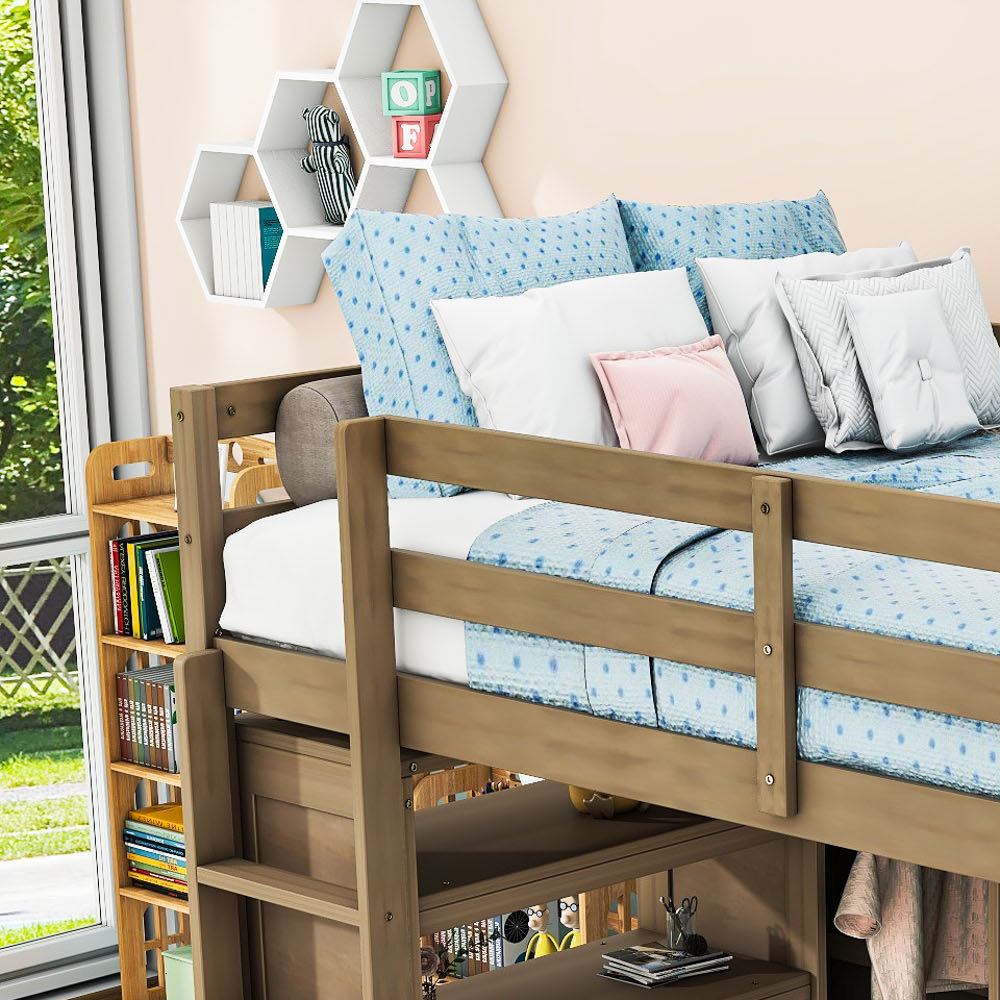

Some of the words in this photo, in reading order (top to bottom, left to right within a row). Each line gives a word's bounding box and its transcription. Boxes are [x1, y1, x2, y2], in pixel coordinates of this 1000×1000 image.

[391, 81, 417, 107] O
[425, 80, 436, 106] P
[400, 124, 420, 150] F
